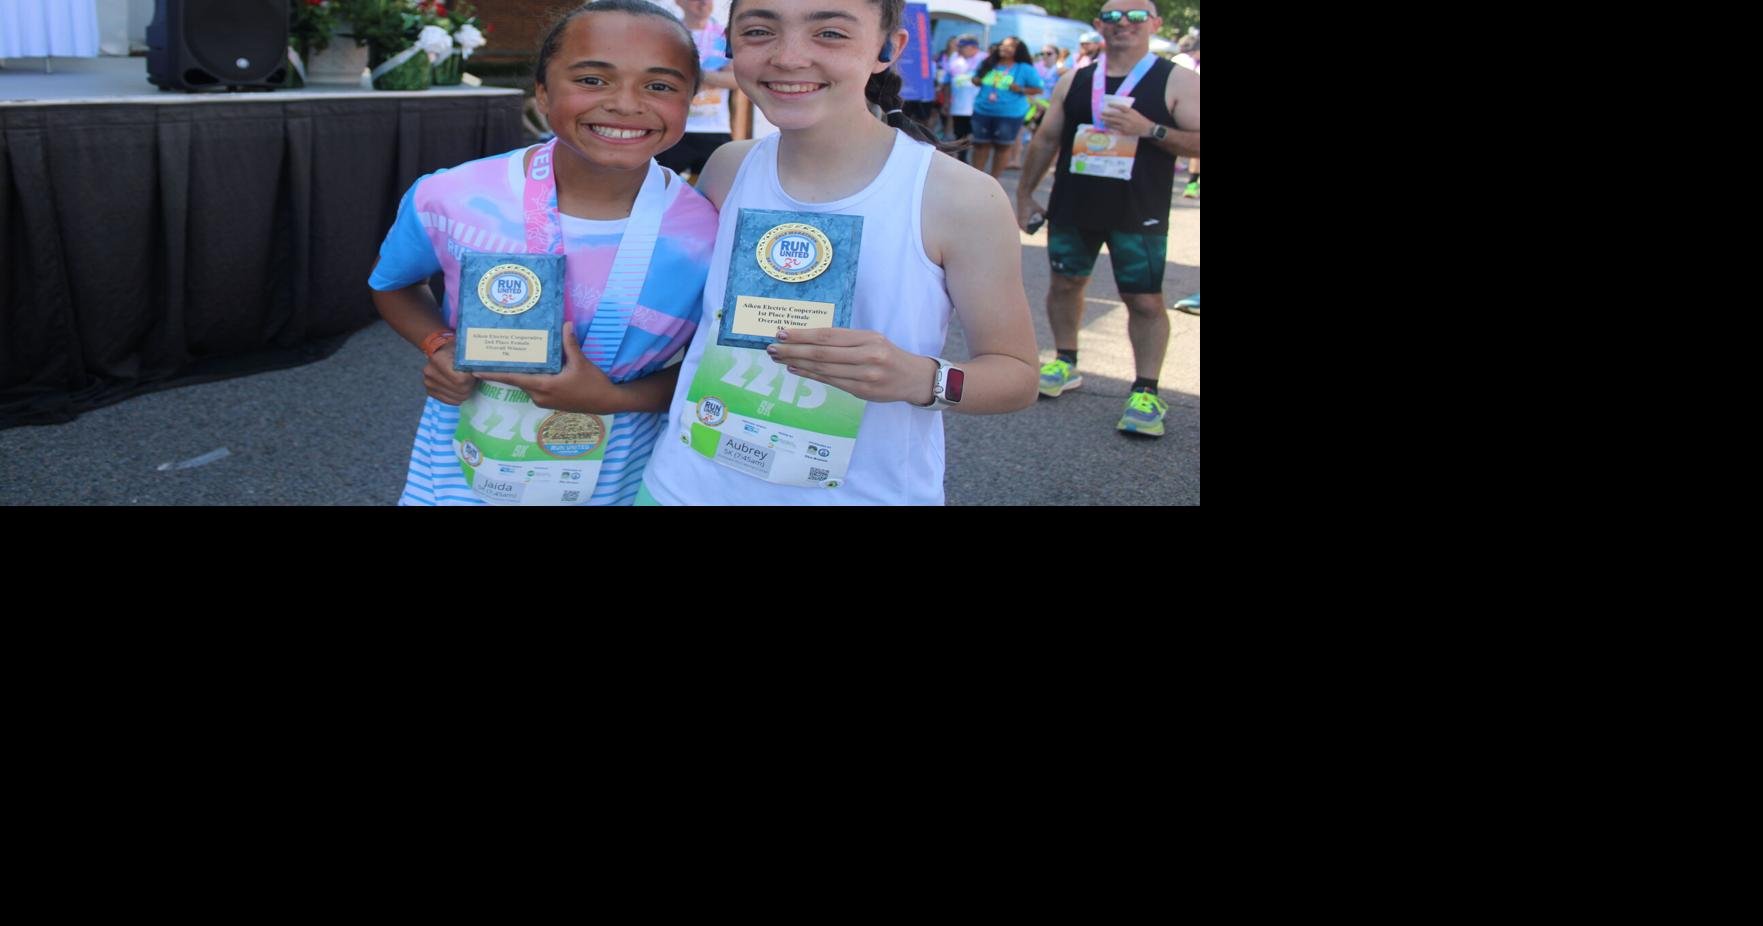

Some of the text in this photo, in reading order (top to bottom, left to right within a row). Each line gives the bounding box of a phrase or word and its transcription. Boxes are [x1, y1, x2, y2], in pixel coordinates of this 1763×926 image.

[532, 146, 553, 180] ED
[447, 239, 472, 260] RU
[781, 241, 809, 252] RUN
[780, 250, 809, 258] UNITED
[498, 280, 521, 288] RUN
[789, 306, 828, 315] Cooperative
[784, 319, 808, 327] Winner
[704, 401, 722, 413] RUN
[726, 439, 768, 461] Aubrey
[482, 479, 513, 492] Jaida
